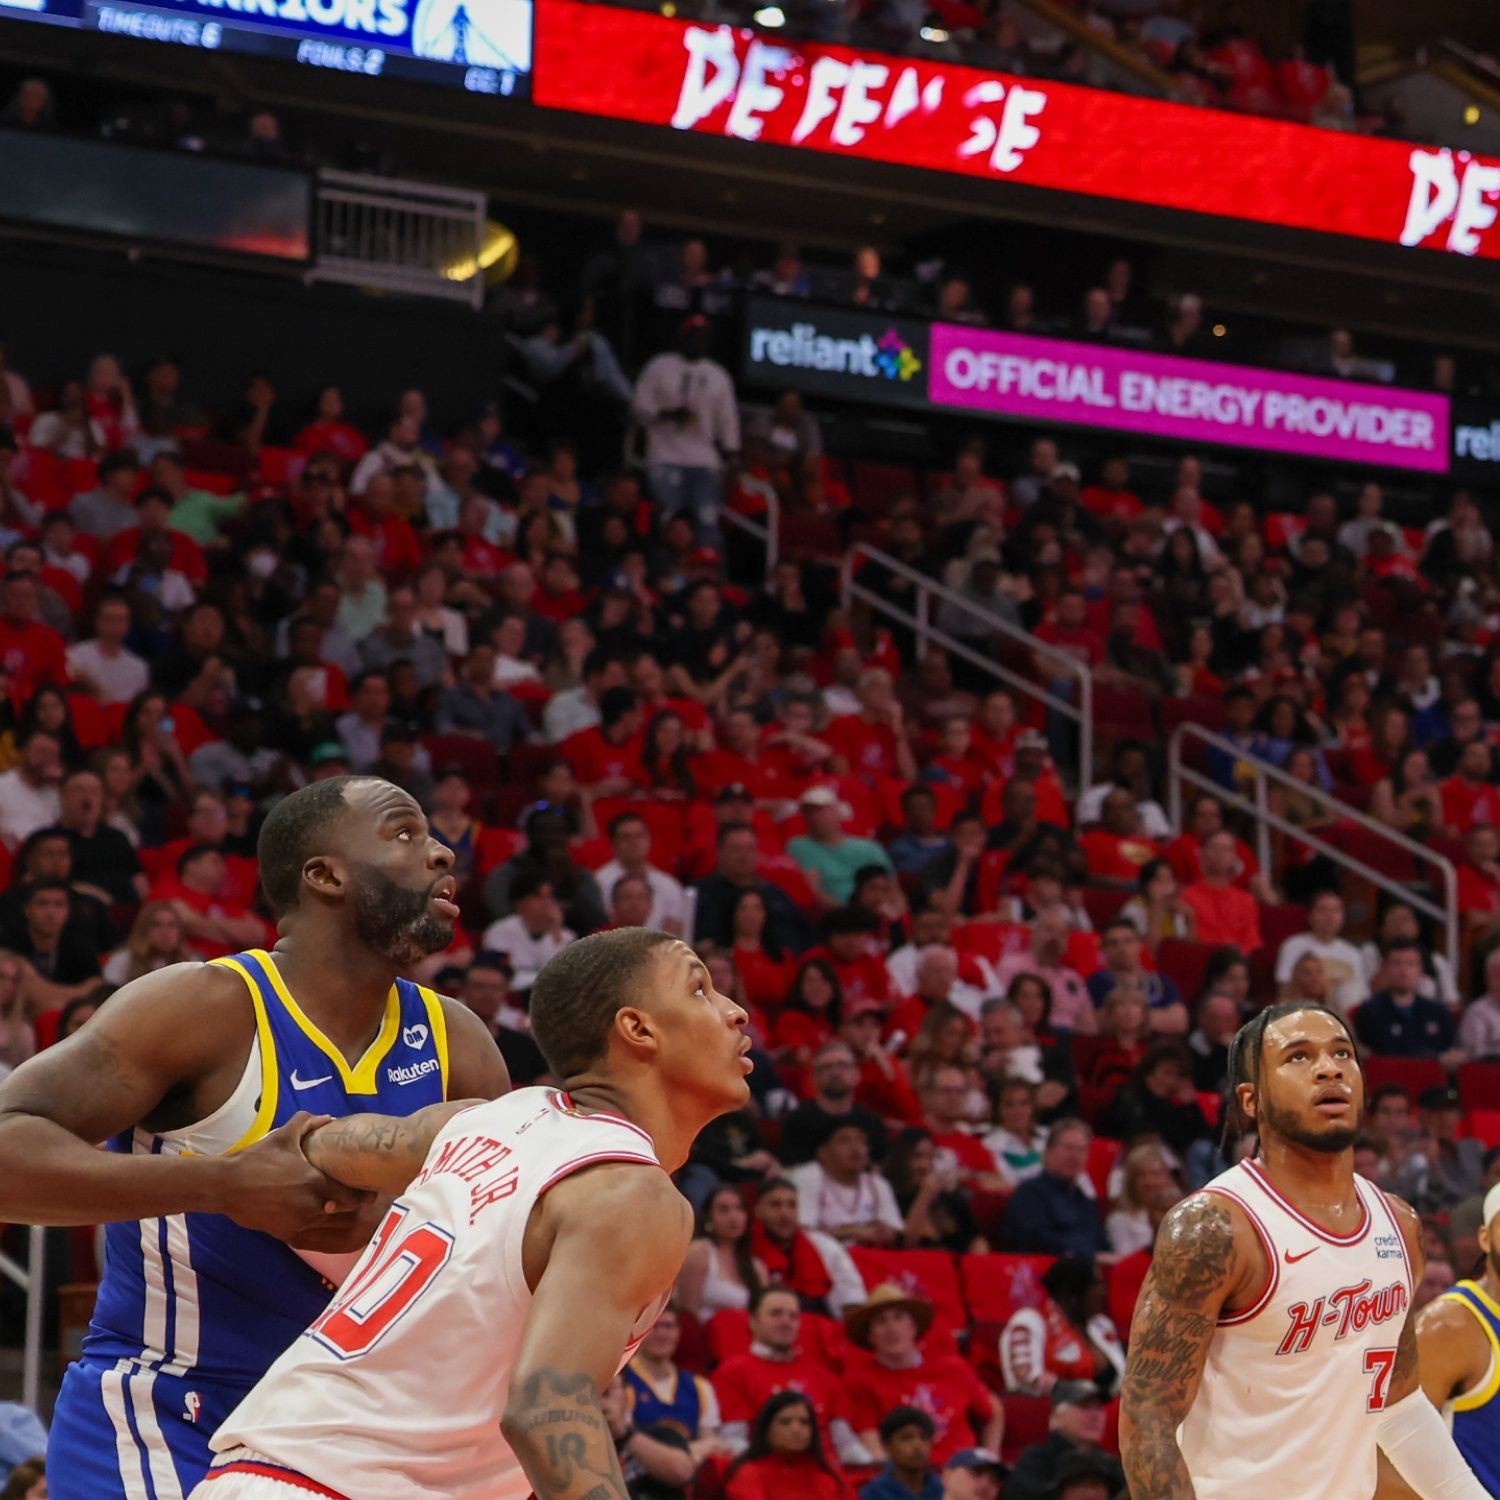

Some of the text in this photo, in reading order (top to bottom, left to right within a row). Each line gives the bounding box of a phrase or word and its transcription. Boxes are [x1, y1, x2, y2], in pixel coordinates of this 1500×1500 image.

[750, 322, 881, 377] reliant
[943, 347, 1434, 451] OFFICIAL ENERGY PROVIDER
[387, 1058, 440, 1083] Rakuten
[1374, 1234, 1399, 1247] credit
[1375, 1246, 1403, 1260] karma
[1275, 1278, 1408, 1356] H-Town
[1362, 1346, 1399, 1414] 7
